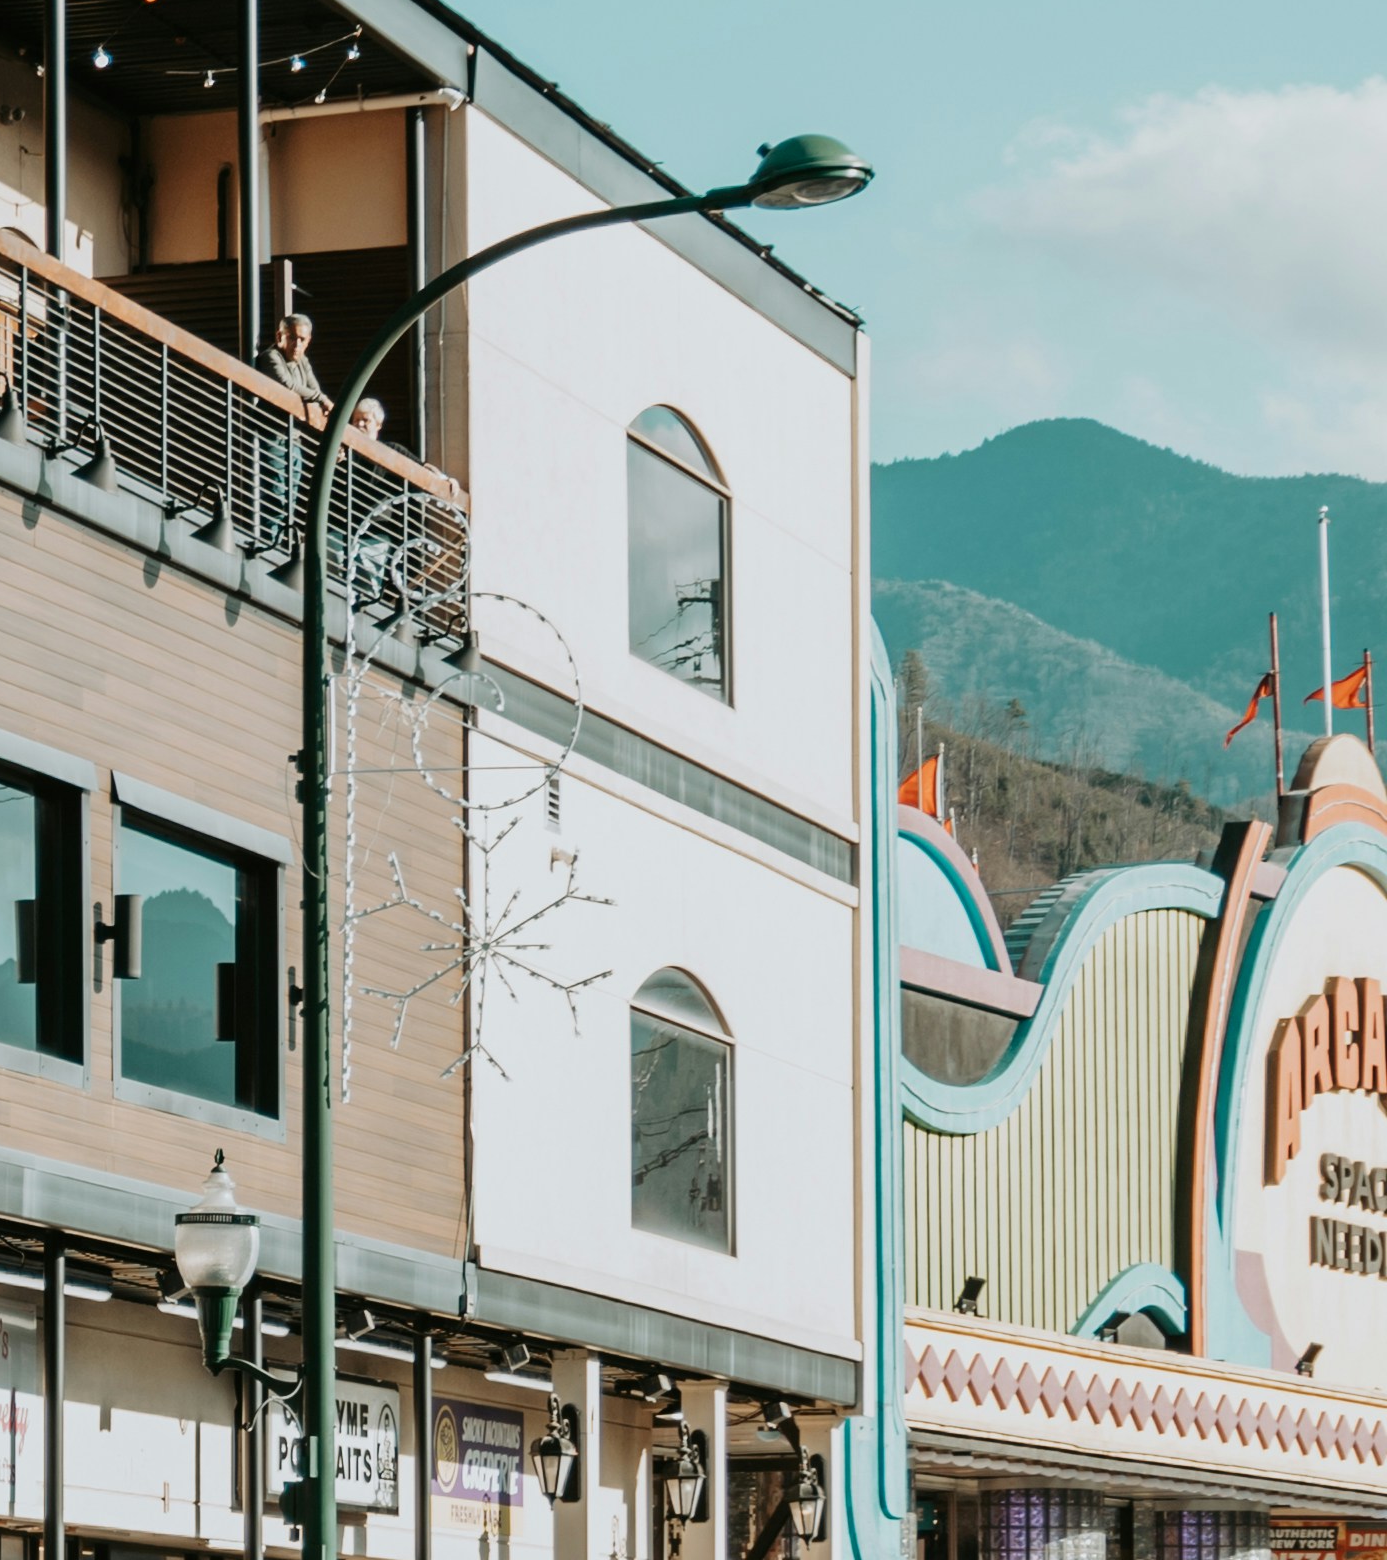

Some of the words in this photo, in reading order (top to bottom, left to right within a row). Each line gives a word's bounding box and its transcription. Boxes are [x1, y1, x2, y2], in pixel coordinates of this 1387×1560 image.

[336, 1398, 369, 1438] YME
[1269, 1528, 1335, 1539] AUTHENTIC
[1299, 1540, 1335, 1549] YORK
